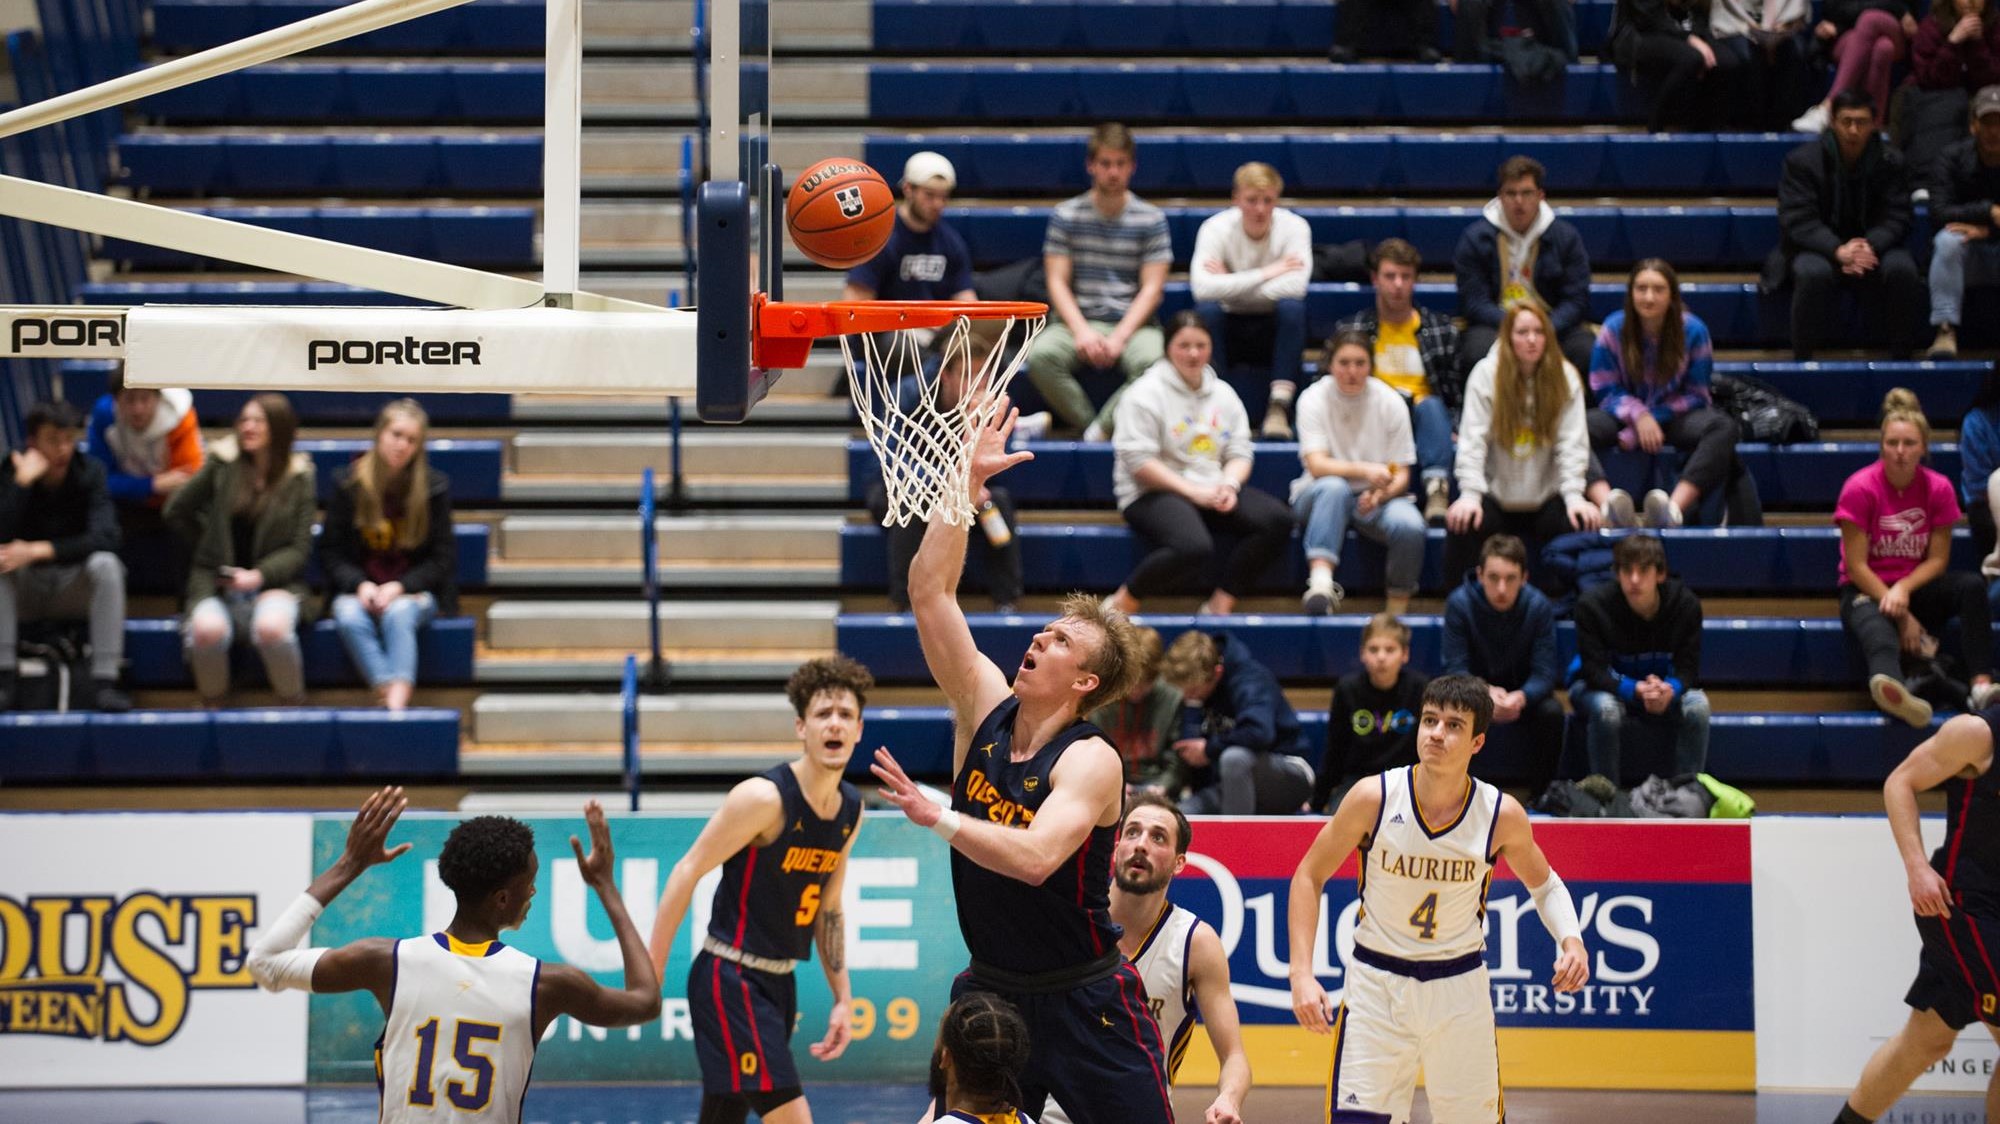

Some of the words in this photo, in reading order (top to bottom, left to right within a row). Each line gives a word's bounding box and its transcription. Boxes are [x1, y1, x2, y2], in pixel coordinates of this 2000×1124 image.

[800, 164, 872, 193] Wilson
[11, 318, 125, 353] por
[1381, 849, 1476, 883] LAURIER
[794, 883, 821, 926] 5
[1409, 891, 1439, 941] 4
[1493, 983, 1655, 1015] ERSITY
[408, 1016, 503, 1114] 15
